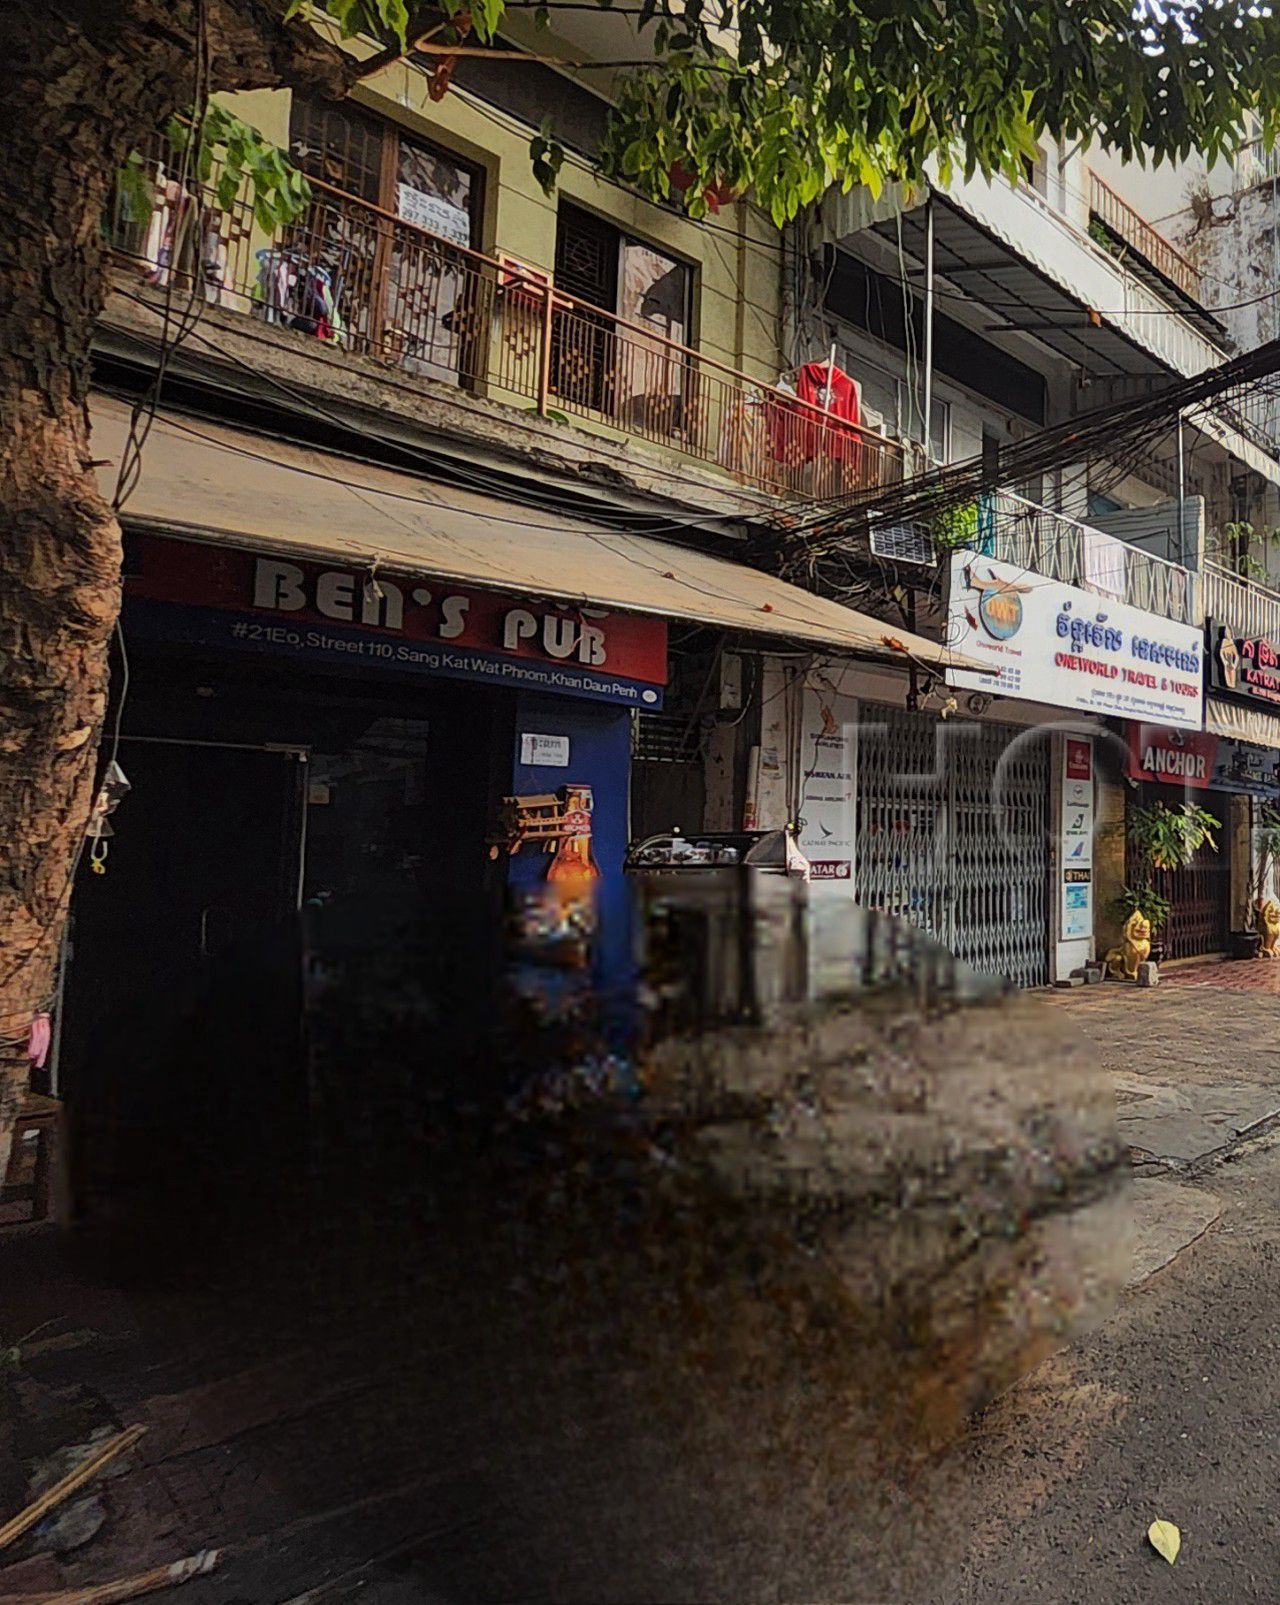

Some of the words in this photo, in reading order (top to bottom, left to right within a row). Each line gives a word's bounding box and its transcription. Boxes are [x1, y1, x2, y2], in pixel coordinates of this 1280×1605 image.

[504, 609, 607, 665] PUB
[442, 653, 469, 670] Kat
[471, 658, 500, 675] Wat
[584, 678, 611, 694] Daun
[612, 683, 638, 699] Penh
[1054, 651, 1119, 680] ONEWORLD
[1121, 667, 1157, 690] TRAVEL
[1170, 678, 1200, 700] TOURS
[1143, 745, 1207, 779] ANCHOR
